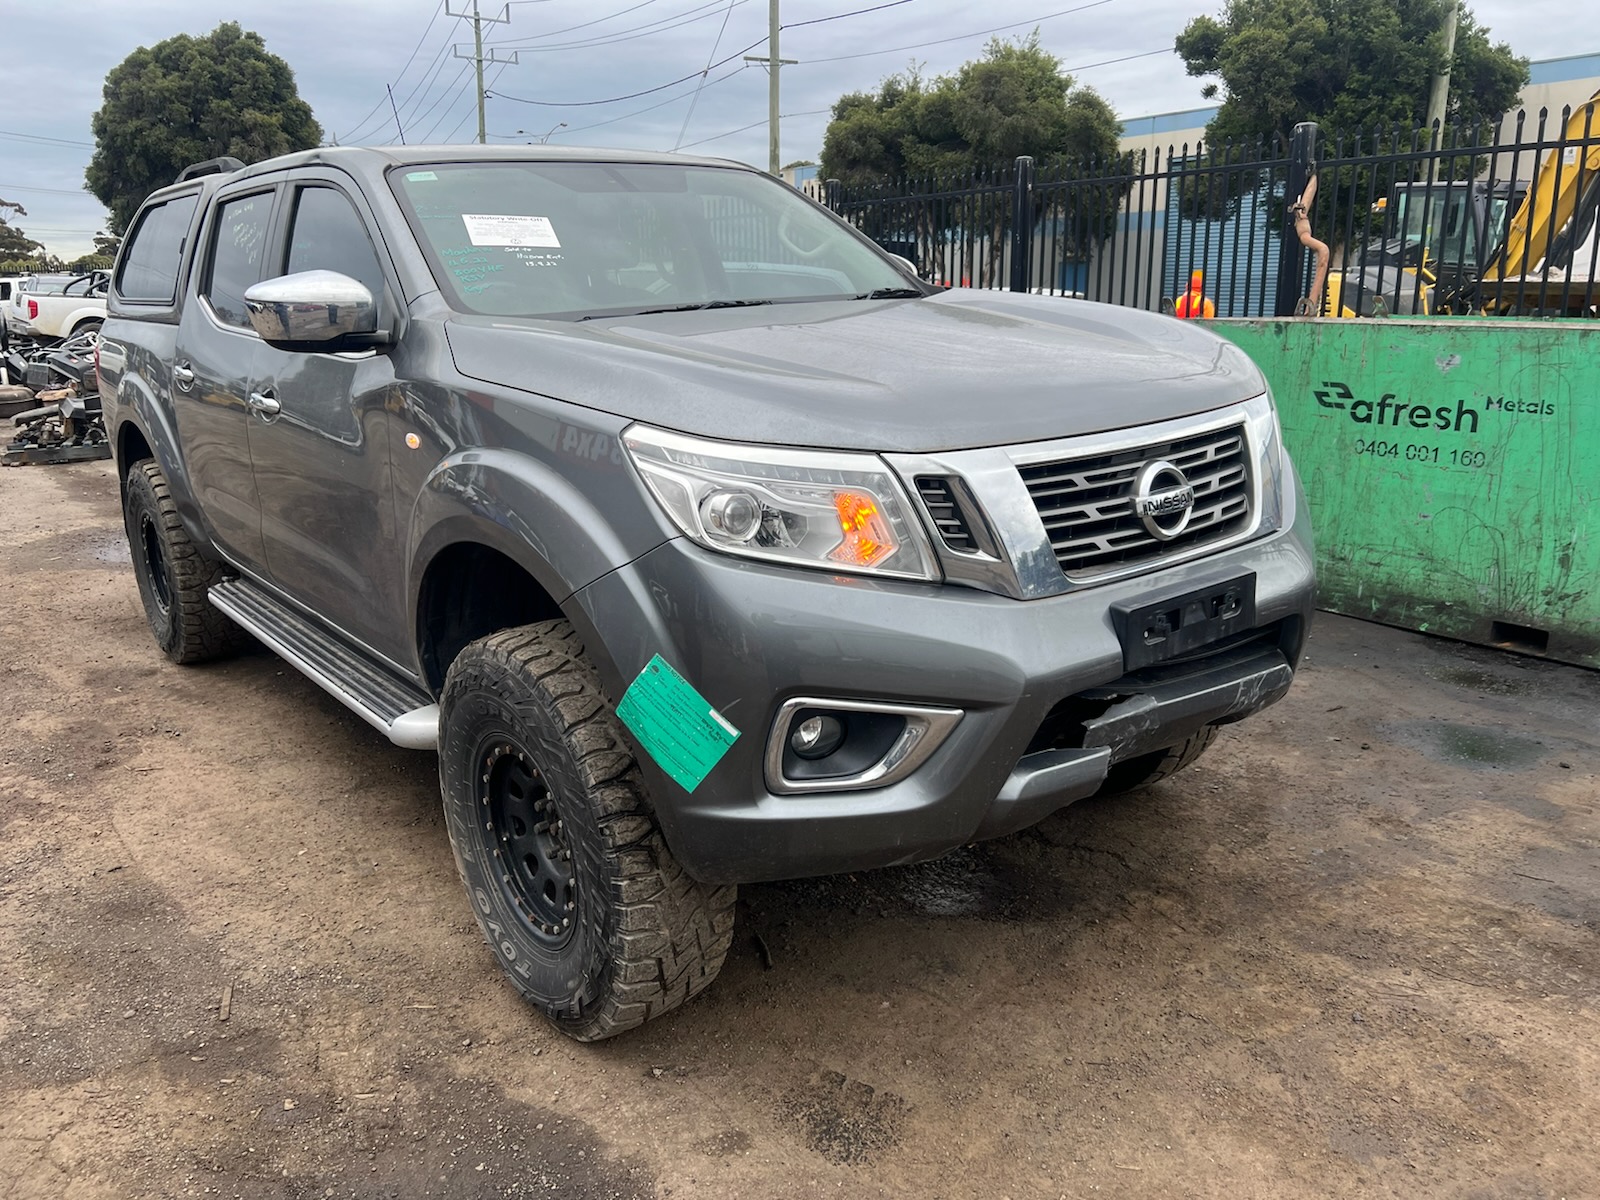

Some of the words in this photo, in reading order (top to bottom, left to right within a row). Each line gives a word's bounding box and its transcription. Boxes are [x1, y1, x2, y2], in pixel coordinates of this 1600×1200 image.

[1350, 393, 1479, 433] afresh
[1485, 395, 1556, 416] Metals
[1354, 438, 1399, 459] 0404
[1405, 444, 1440, 463] 001
[1449, 450, 1486, 468] 160
[1146, 490, 1193, 512] NISSAN
[655, 655, 672, 672] TOWING
[670, 669, 686, 686] NOTICE
[474, 887, 532, 980] TOYO
